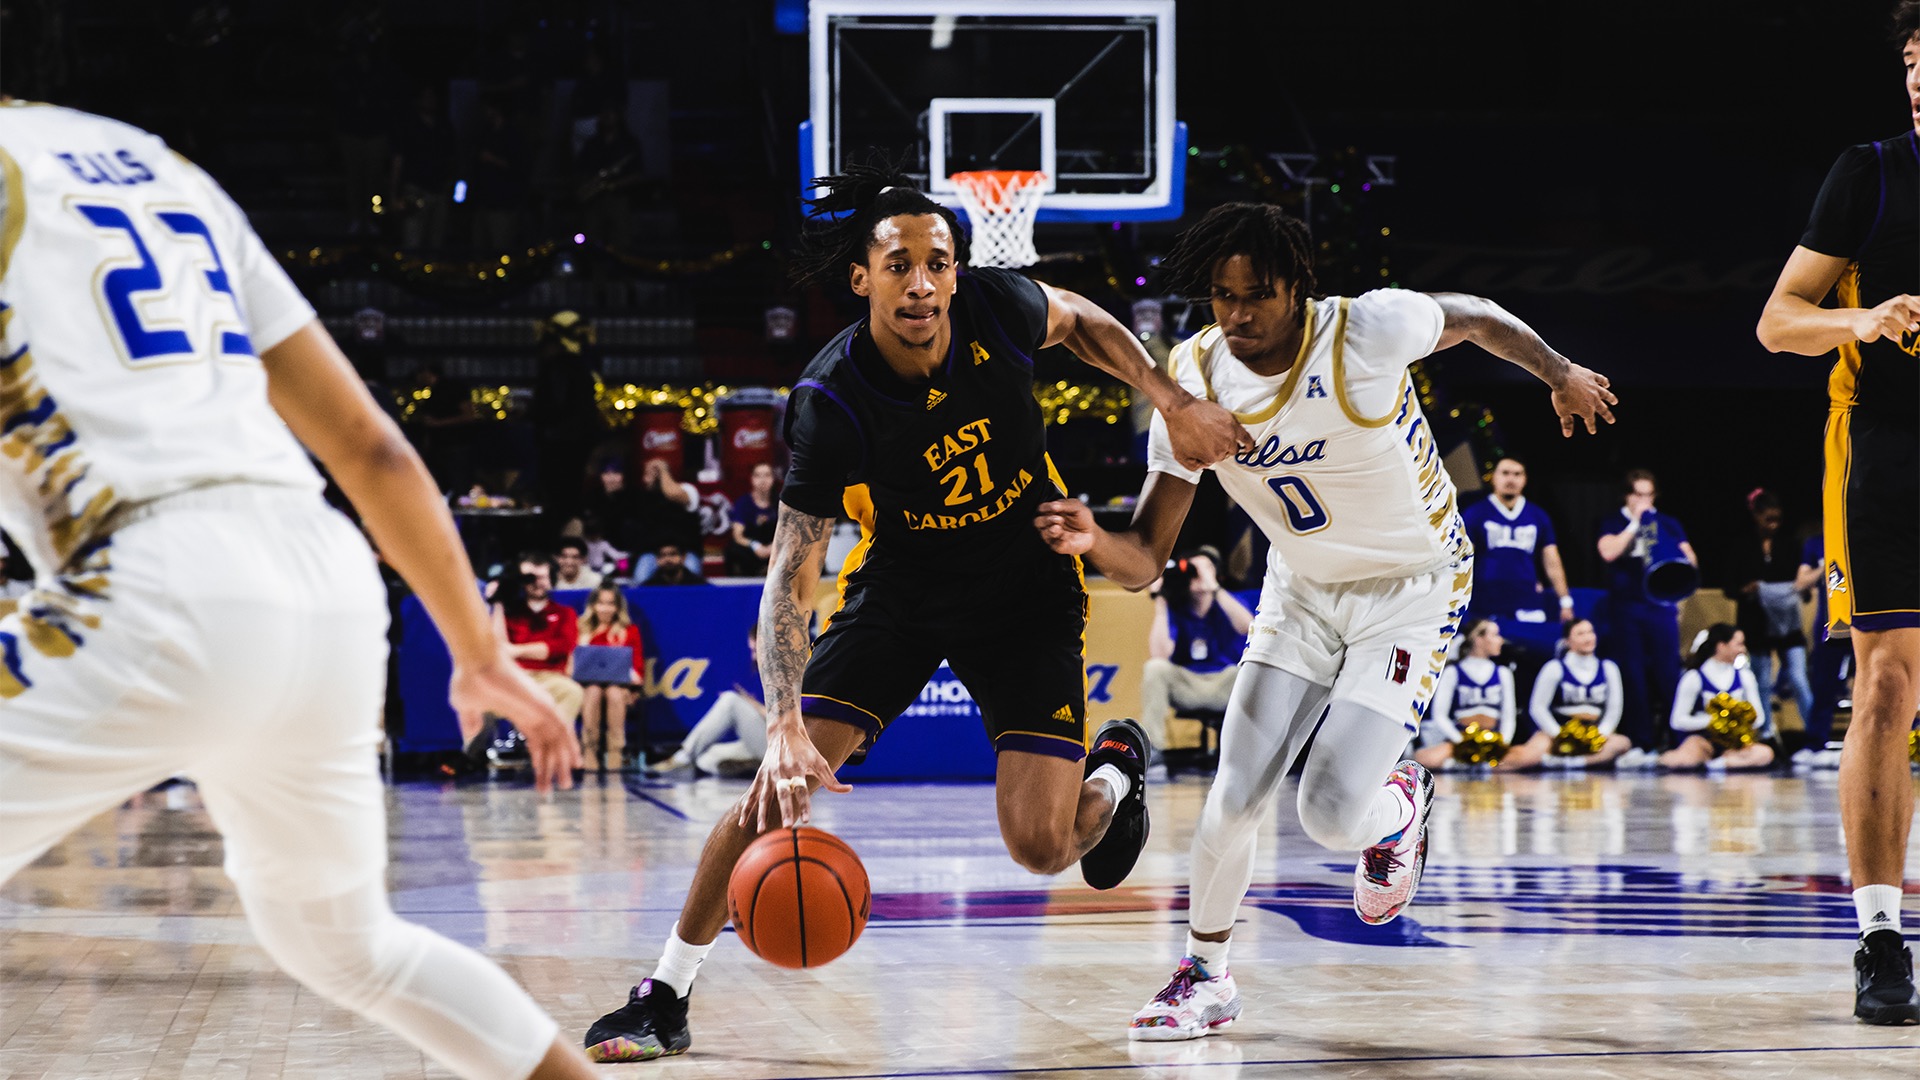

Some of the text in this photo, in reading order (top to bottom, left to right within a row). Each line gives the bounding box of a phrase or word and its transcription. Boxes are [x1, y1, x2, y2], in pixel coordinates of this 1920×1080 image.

[922, 417, 993, 473] EAST
[1234, 433, 1328, 469] ulsa
[903, 467, 1034, 531] CAROLINA
[939, 452, 995, 507] 21
[1264, 473, 1330, 534] 0
